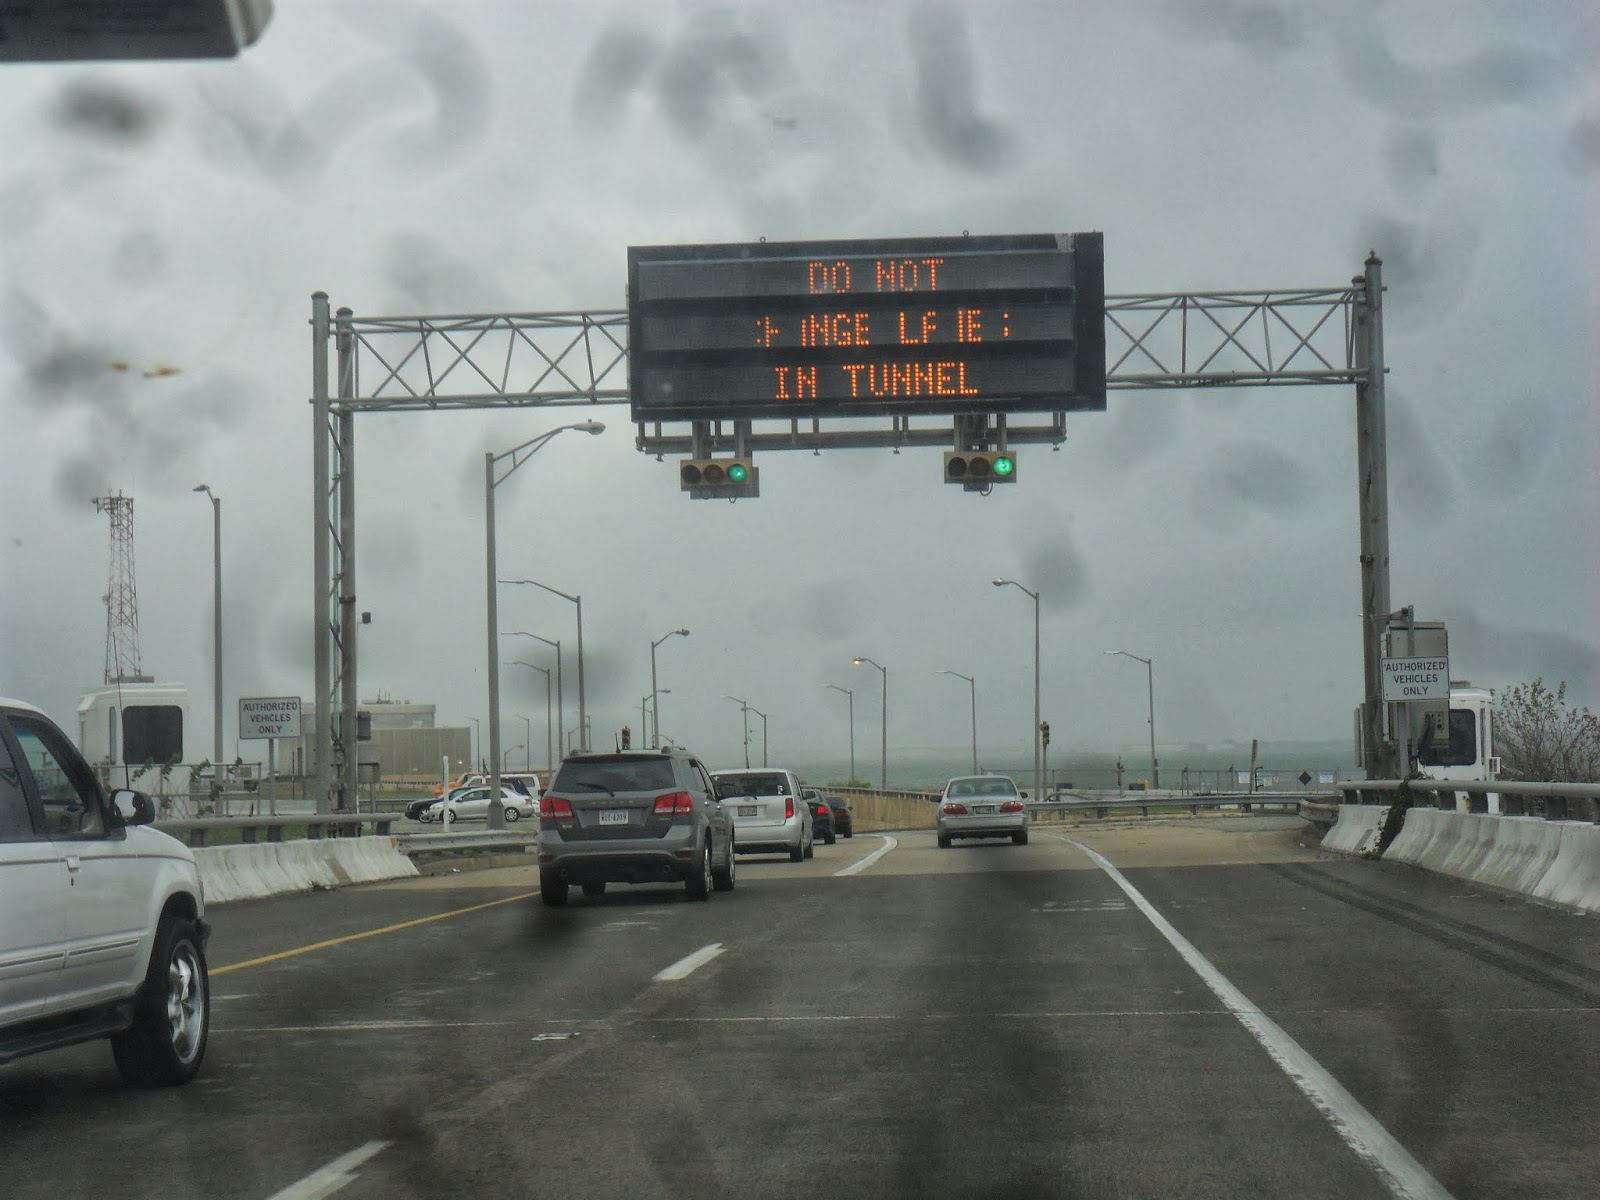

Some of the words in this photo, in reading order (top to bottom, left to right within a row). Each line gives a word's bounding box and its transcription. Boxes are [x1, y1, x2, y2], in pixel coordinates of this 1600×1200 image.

[809, 261, 850, 294] DO
[876, 258, 944, 292] NOT
[756, 313, 870, 347] HNGE
[775, 366, 817, 399] IN
[843, 361, 979, 397] TUNNEL
[1384, 660, 1446, 672] AUTHORIZED
[1393, 673, 1438, 684] VEHICLES
[1403, 686, 1429, 696] ONLY
[243, 701, 298, 712] AUTHORIZED
[250, 713, 291, 723] VEHICLES
[259, 725, 282, 734] ONLY
